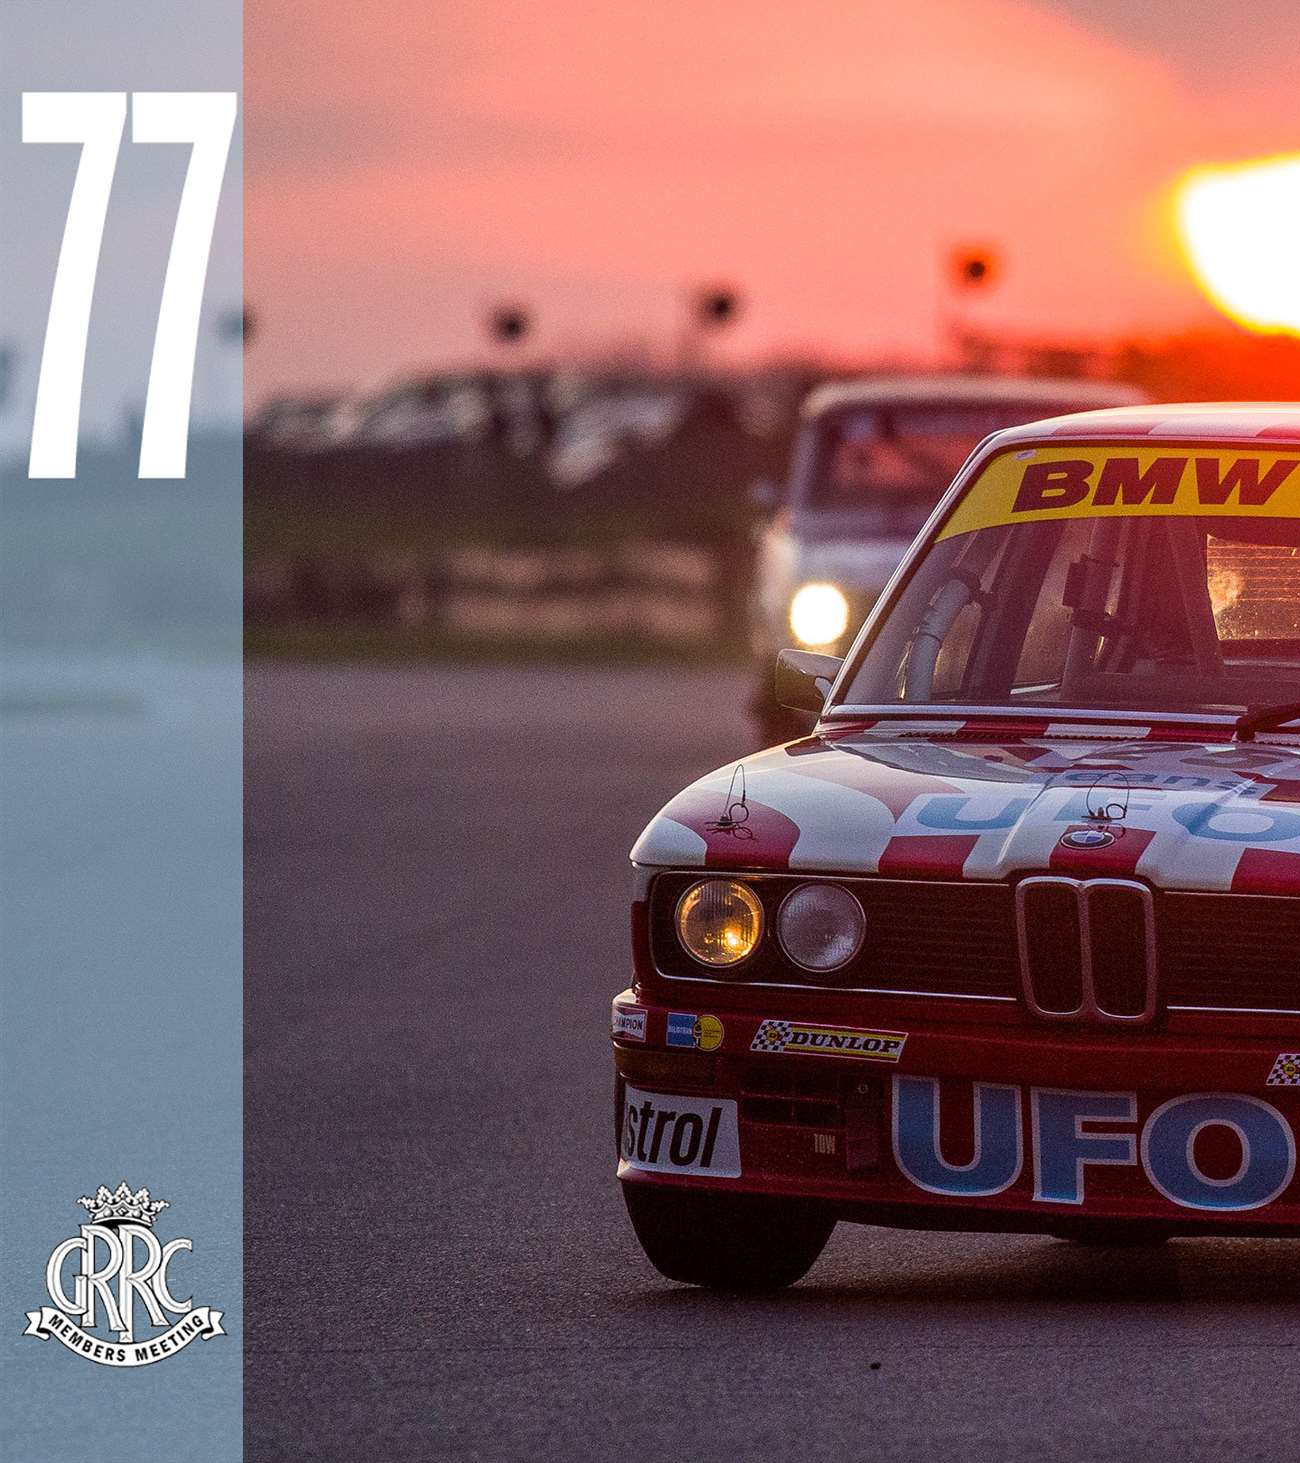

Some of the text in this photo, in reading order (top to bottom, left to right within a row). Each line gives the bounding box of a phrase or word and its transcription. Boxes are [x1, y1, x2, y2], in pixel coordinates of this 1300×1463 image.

[1011, 457, 1300, 514] BMW
[788, 1031, 900, 1053] DUNLOP
[625, 1101, 722, 1168] strol
[813, 1132, 836, 1155] TOW
[891, 1073, 1297, 1212] UFO
